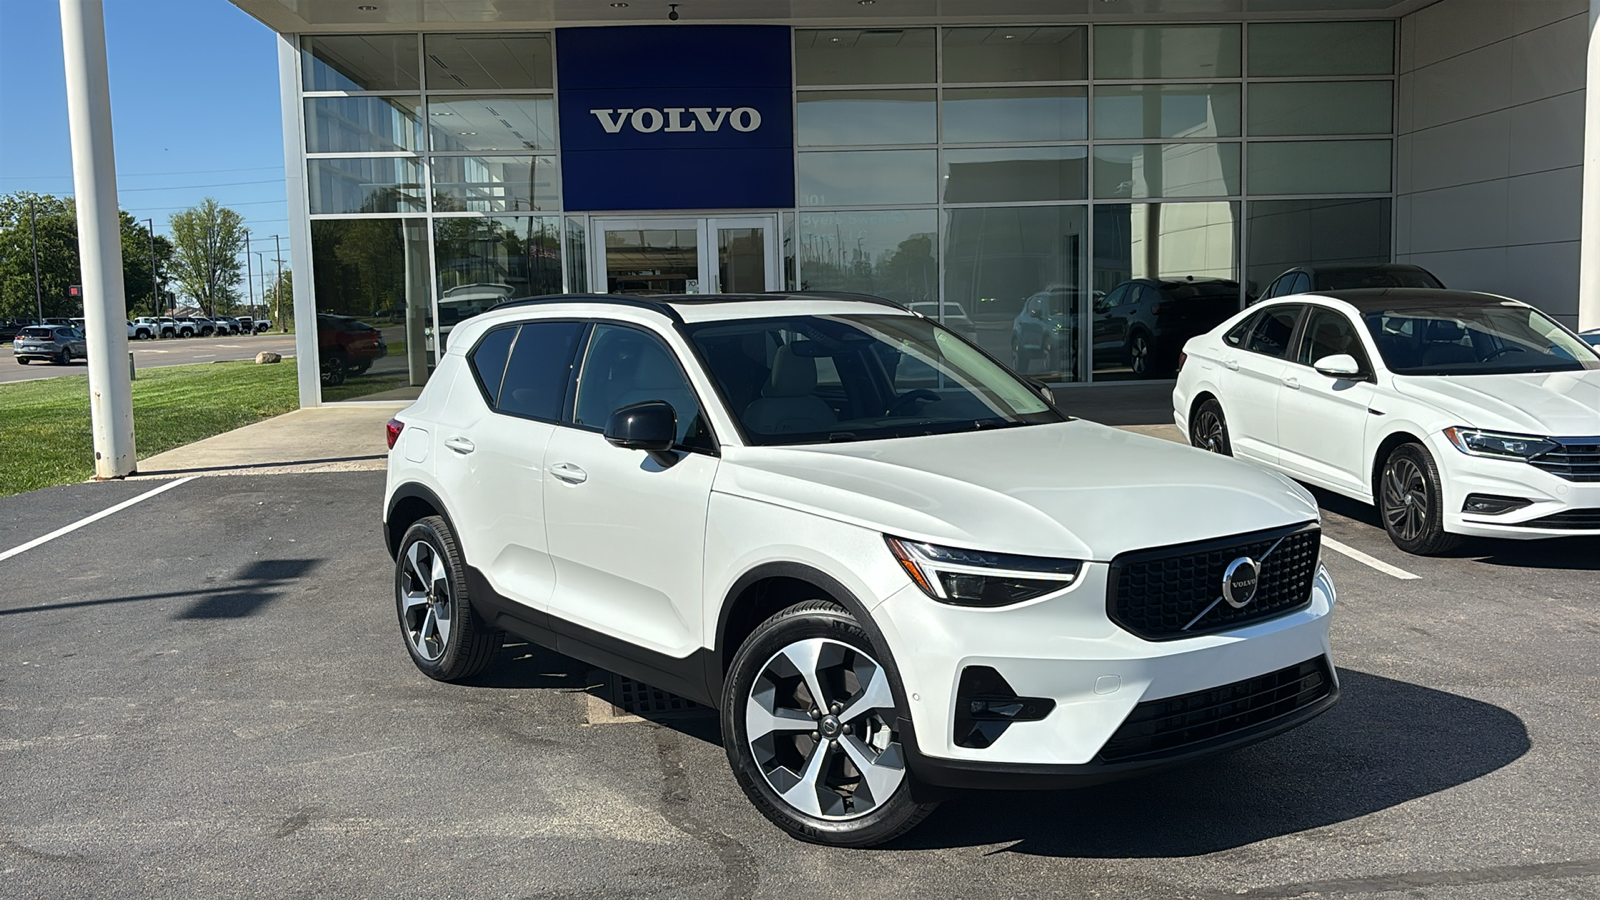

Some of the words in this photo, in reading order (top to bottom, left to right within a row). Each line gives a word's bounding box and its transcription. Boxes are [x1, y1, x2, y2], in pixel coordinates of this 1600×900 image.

[590, 107, 762, 133] VOLVO
[803, 215, 841, 228] Byers
[1232, 579, 1255, 588] VOLVO
